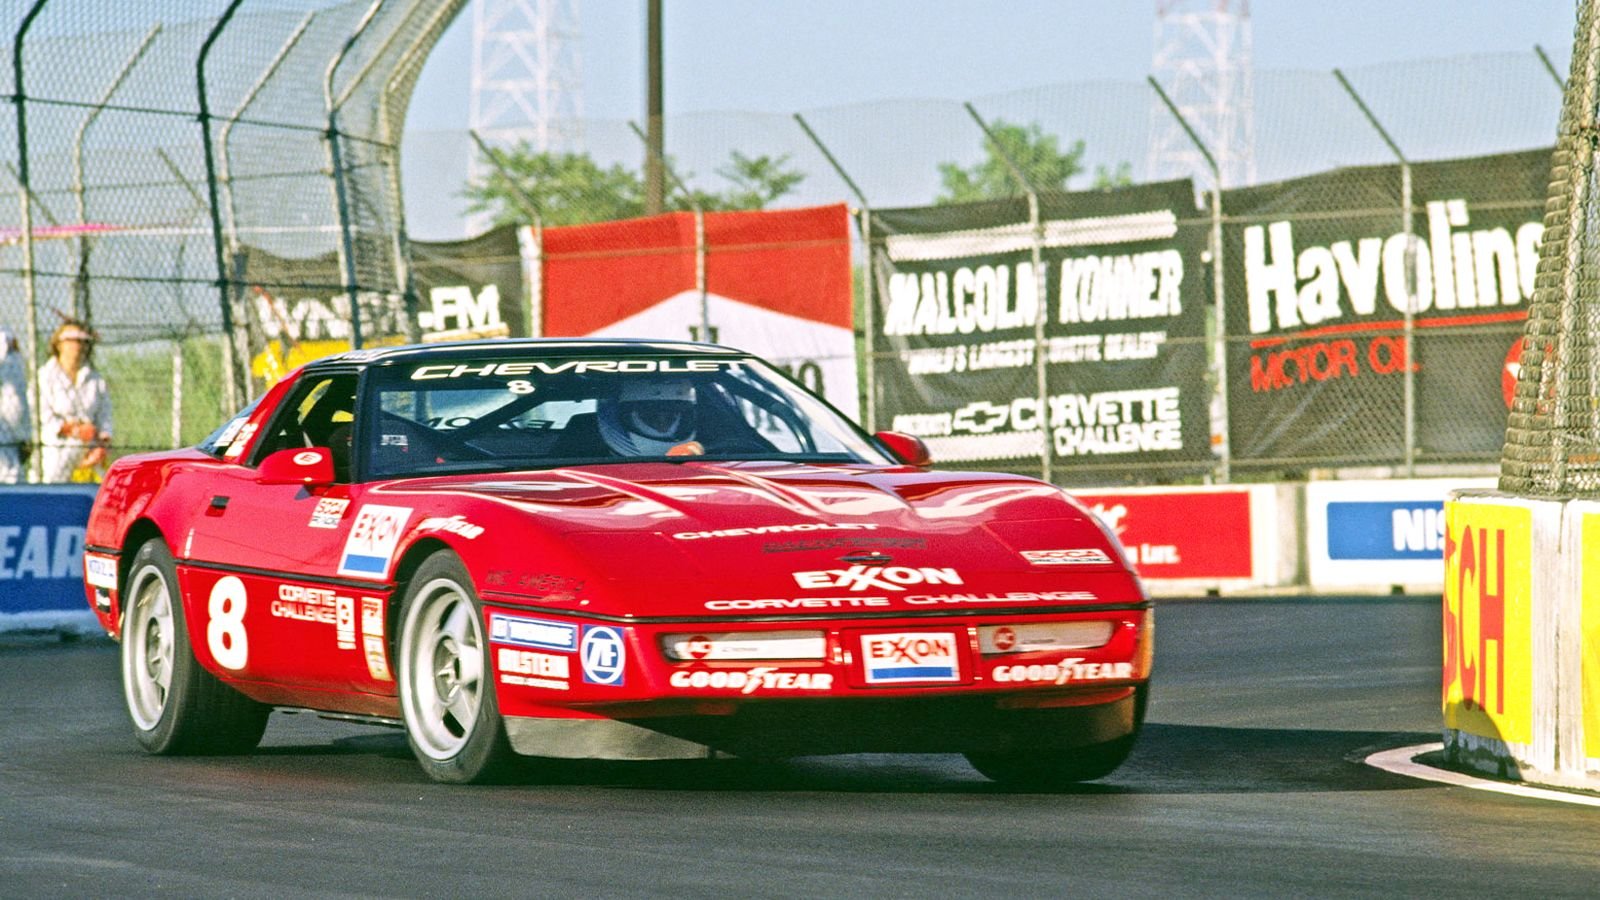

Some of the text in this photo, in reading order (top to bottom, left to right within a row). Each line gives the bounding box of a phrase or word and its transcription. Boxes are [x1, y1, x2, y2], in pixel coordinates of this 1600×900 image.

[1244, 199, 1545, 334] Havoline
[884, 249, 1184, 336] MALCOLM KONNER
[410, 359, 749, 380] CHEVROLET
[1250, 340, 1358, 393] MOTOR
[506, 380, 536, 394] 8
[1053, 419, 1183, 457] CHALLENGE
[353, 512, 400, 551] EXXON
[672, 523, 879, 540] CHEVROLET
[792, 565, 964, 592] EXXON
[278, 584, 336, 607] CORVETTE
[704, 591, 1098, 610] CORVETTE CHALLENGE
[206, 575, 249, 671] 8
[271, 601, 337, 625] CHALLENGE
[870, 637, 951, 665] EXXON
[669, 667, 834, 694] GOODYEAR
[992, 657, 1133, 685] GOODYEAR
